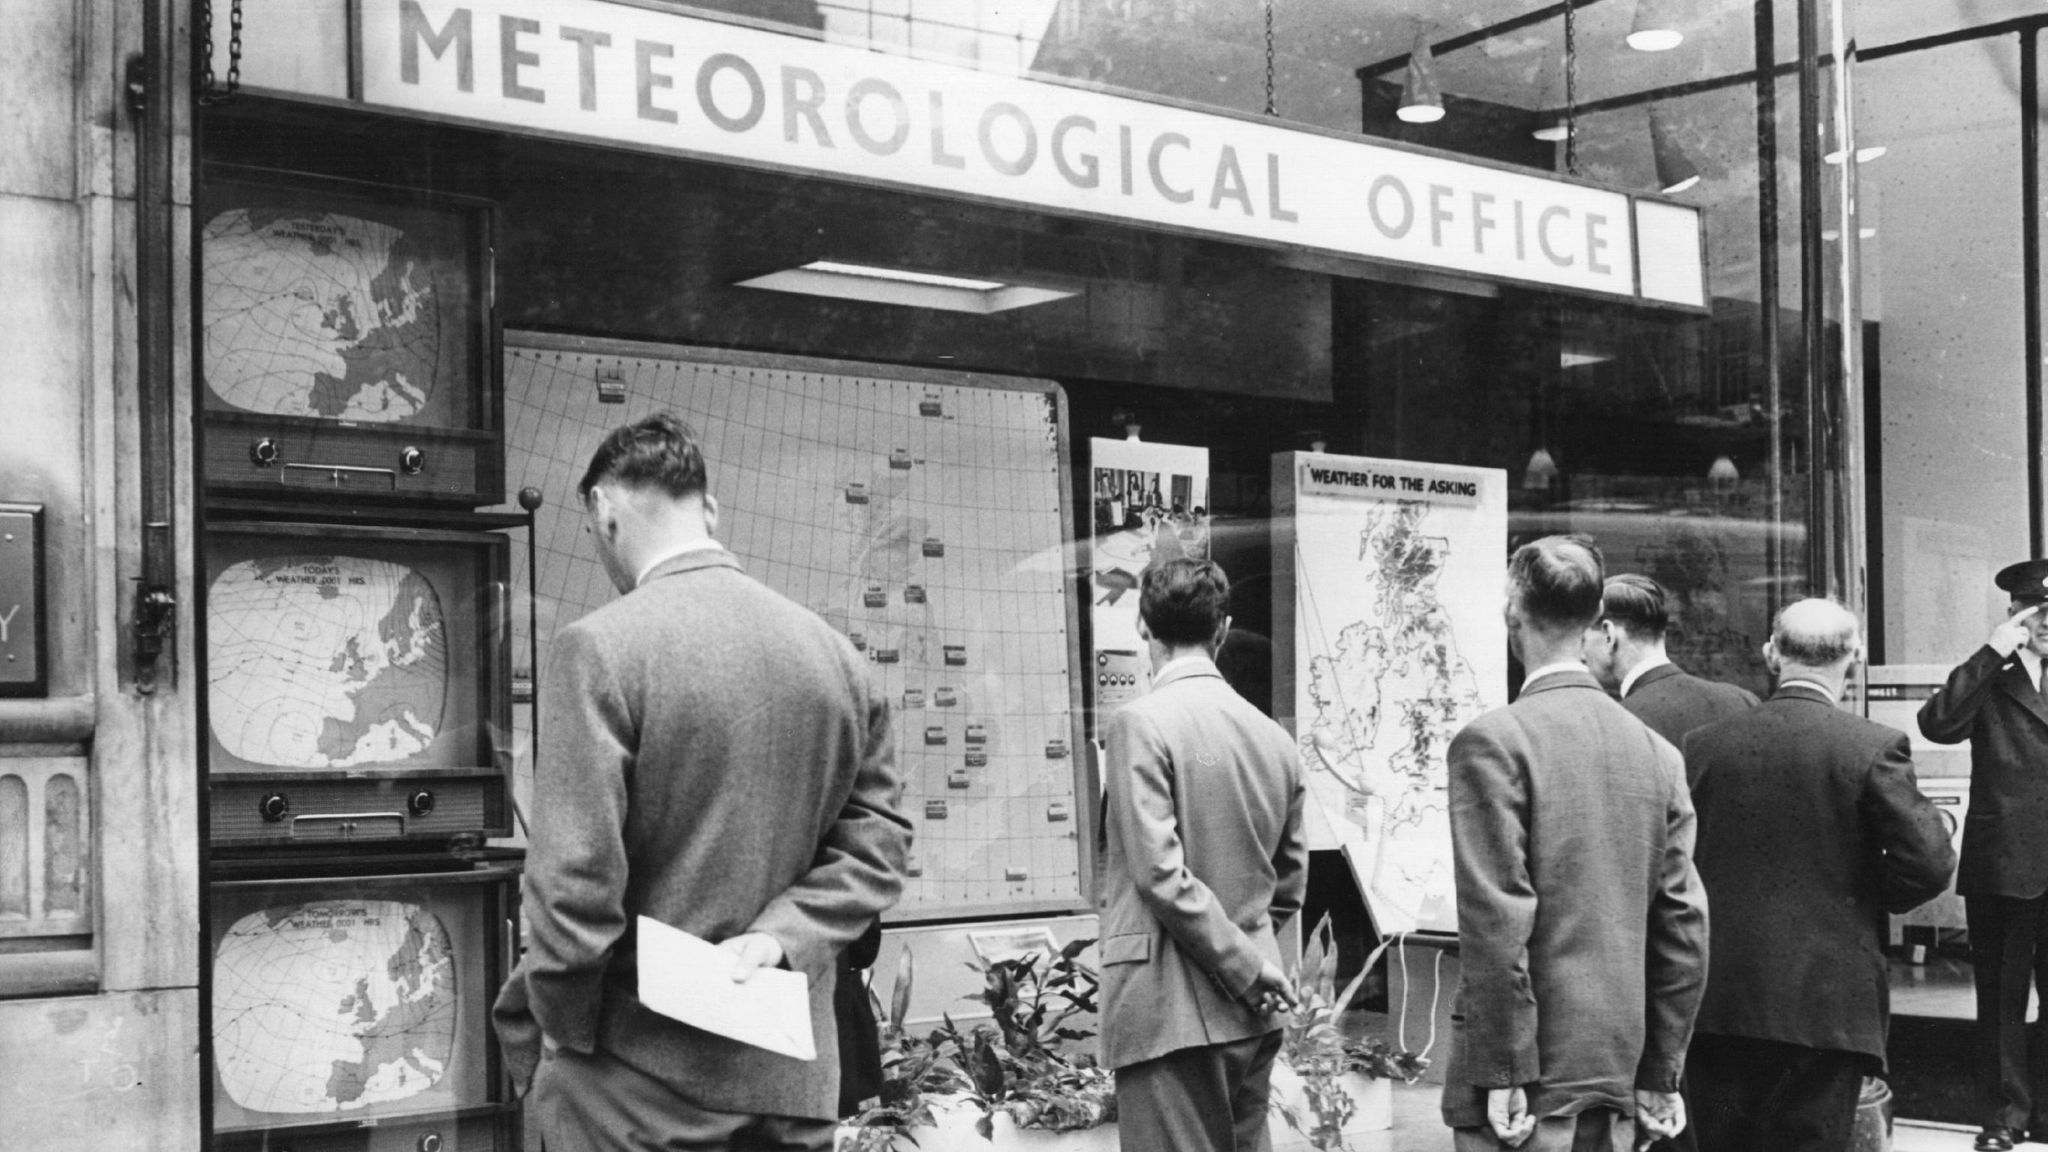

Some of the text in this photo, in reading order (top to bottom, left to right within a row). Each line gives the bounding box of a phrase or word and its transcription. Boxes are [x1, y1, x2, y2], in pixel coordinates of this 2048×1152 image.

[400, 0, 1612, 275] METEOROLOGICAL OFFICE
[272, 229, 316, 242] WEATHER
[1372, 473, 1396, 490] FOR
[1400, 476, 1424, 492] THE
[1428, 480, 1476, 497] ASKING
[303, 566, 341, 575] TODAY'S
[275, 575, 317, 585] WEATHER
[292, 918, 332, 929] WEATHER
